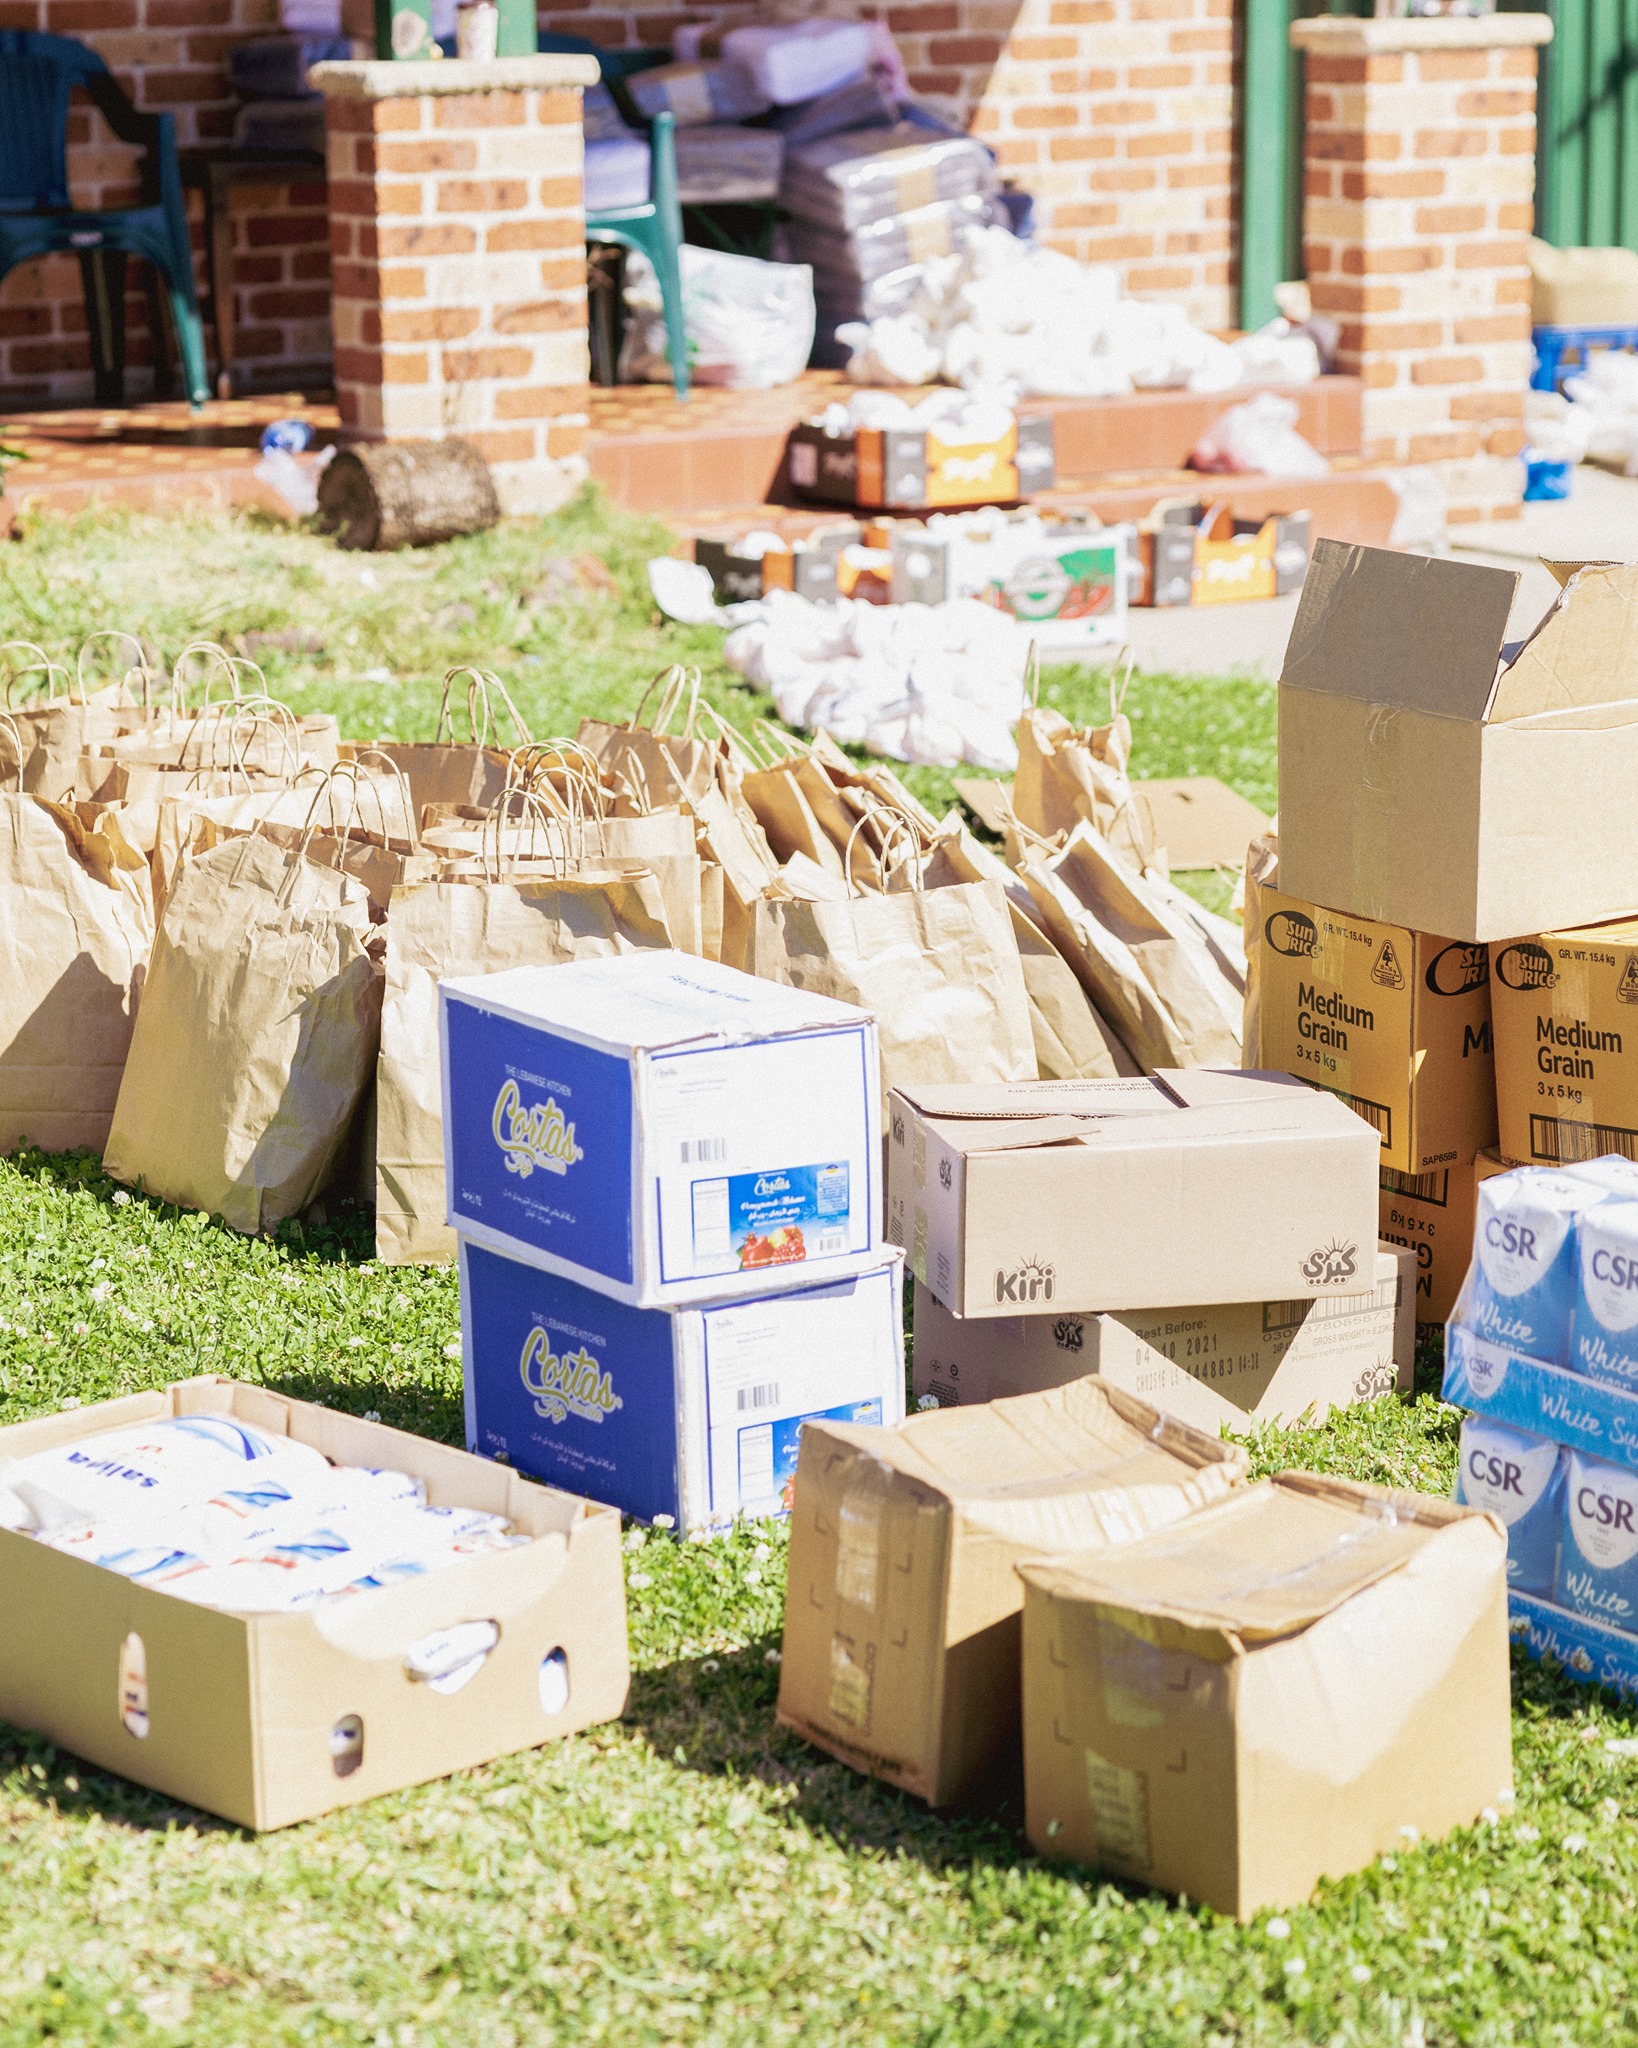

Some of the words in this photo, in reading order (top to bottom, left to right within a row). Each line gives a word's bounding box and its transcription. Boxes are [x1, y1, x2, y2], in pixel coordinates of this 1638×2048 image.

[1349, 931, 1363, 943] 15.4
[1363, 932, 1373, 948] kg
[1461, 946, 1489, 968] Su
[1558, 948, 1573, 960] GR.
[1574, 950, 1588, 962] WT.
[1589, 952, 1605, 964] 15.4
[1606, 953, 1616, 967] kg
[1298, 981, 1375, 1031] Medium
[1297, 1011, 1348, 1051] Grain
[1537, 1015, 1623, 1054] Medium
[1296, 1044, 1304, 1058] 3
[1305, 1049, 1312, 1061] x
[1314, 1050, 1321, 1064] 5
[1323, 1052, 1337, 1072] kg
[1537, 1045, 1594, 1080] Grain
[1537, 1081, 1545, 1095] 3
[1547, 1085, 1555, 1097] x
[1557, 1084, 1565, 1098] 5
[1567, 1085, 1582, 1104] kg
[493, 1079, 576, 1165] Cortas
[1422, 1150, 1458, 1167] SAP6598
[1391, 1209, 1405, 1229] kg
[1408, 1217, 1415, 1231] 5
[1428, 1223, 1435, 1236] 3
[1485, 1217, 1538, 1261] CSR
[1300, 1244, 1359, 1287] كيري
[1592, 1248, 1638, 1293] CSR
[996, 1265, 1055, 1304] Kiri
[532, 1311, 545, 1325] THE
[545, 1316, 578, 1338] LEBANESE
[579, 1328, 607, 1347] KITCHEN
[1135, 1327, 1162, 1341] Best
[1165, 1320, 1208, 1336] Before:
[1312, 1335, 1337, 1347] GROSS
[1339, 1329, 1365, 1342] WEIGHT
[1475, 1300, 1537, 1344] White
[1186, 1333, 1217, 1357] 2021
[1319, 1341, 1375, 1358] refrigerated
[1580, 1334, 1638, 1380] White
[521, 1326, 616, 1414] Cortas
[1186, 1357, 1233, 1383] 444883
[1470, 1357, 1494, 1378] CSR
[1542, 1393, 1603, 1437] White
[1469, 1449, 1524, 1496] CSR
[1578, 1487, 1636, 1534] CSR
[1566, 1569, 1635, 1617] White
